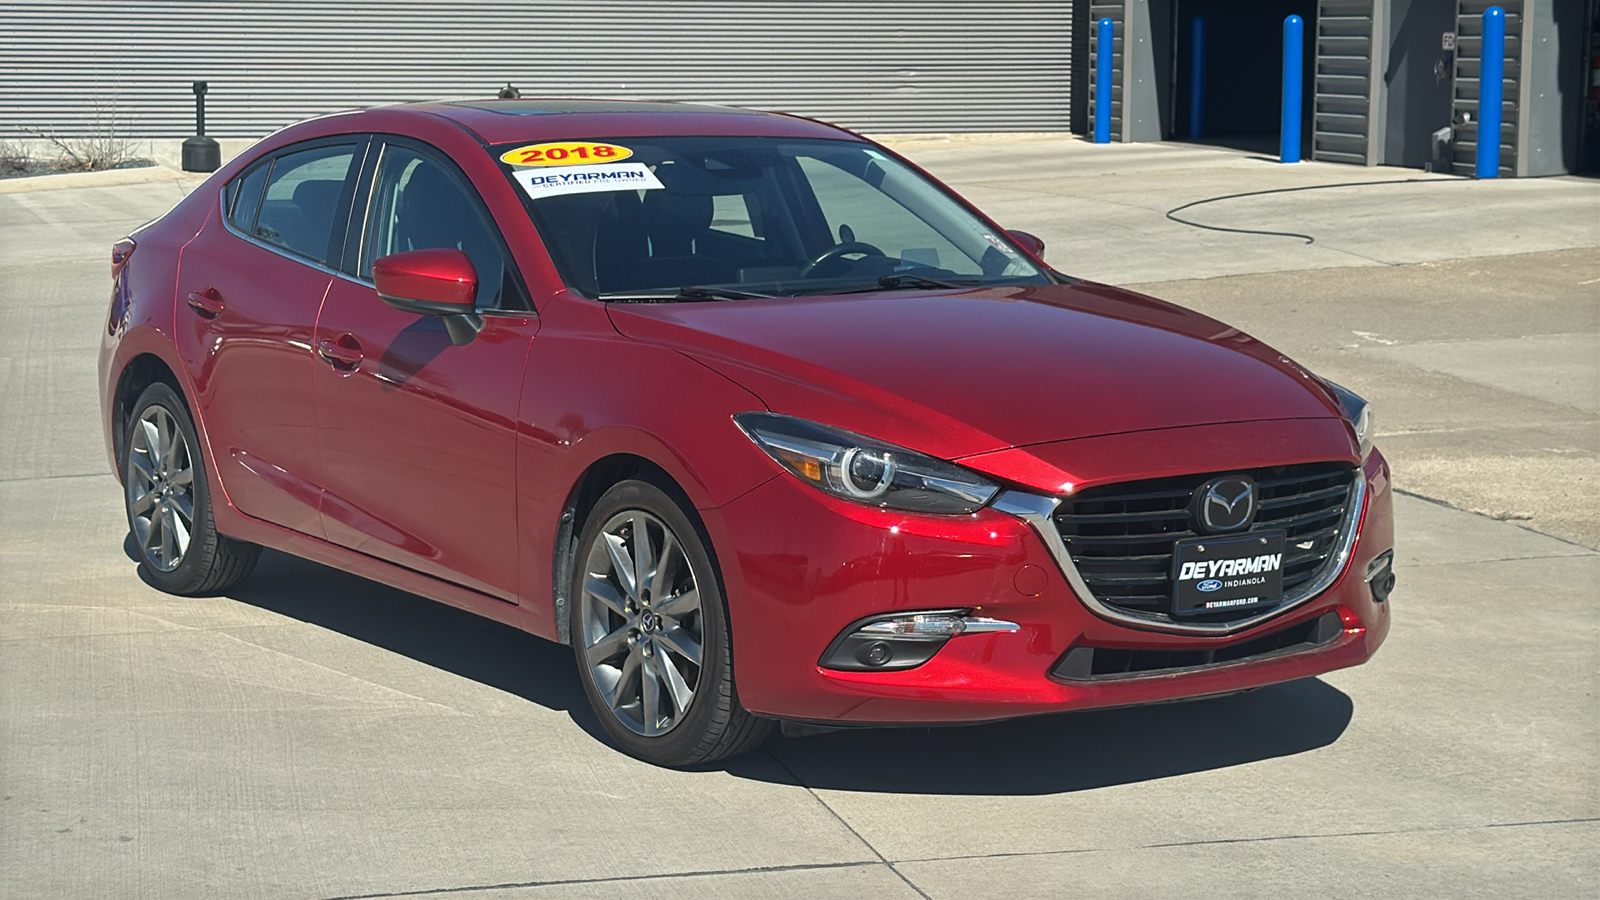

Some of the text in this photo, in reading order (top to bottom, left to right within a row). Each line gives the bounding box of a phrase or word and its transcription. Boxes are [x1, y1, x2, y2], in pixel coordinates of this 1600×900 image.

[520, 146, 616, 163] 2018
[531, 171, 644, 185] DEYARMAN
[542, 180, 591, 188] CERTIFIED
[1178, 553, 1282, 580] DEYARMAN
[1201, 576, 1266, 590] Ford INDIANOLA
[1205, 596, 1258, 608] DEYARMANFORD.COM
